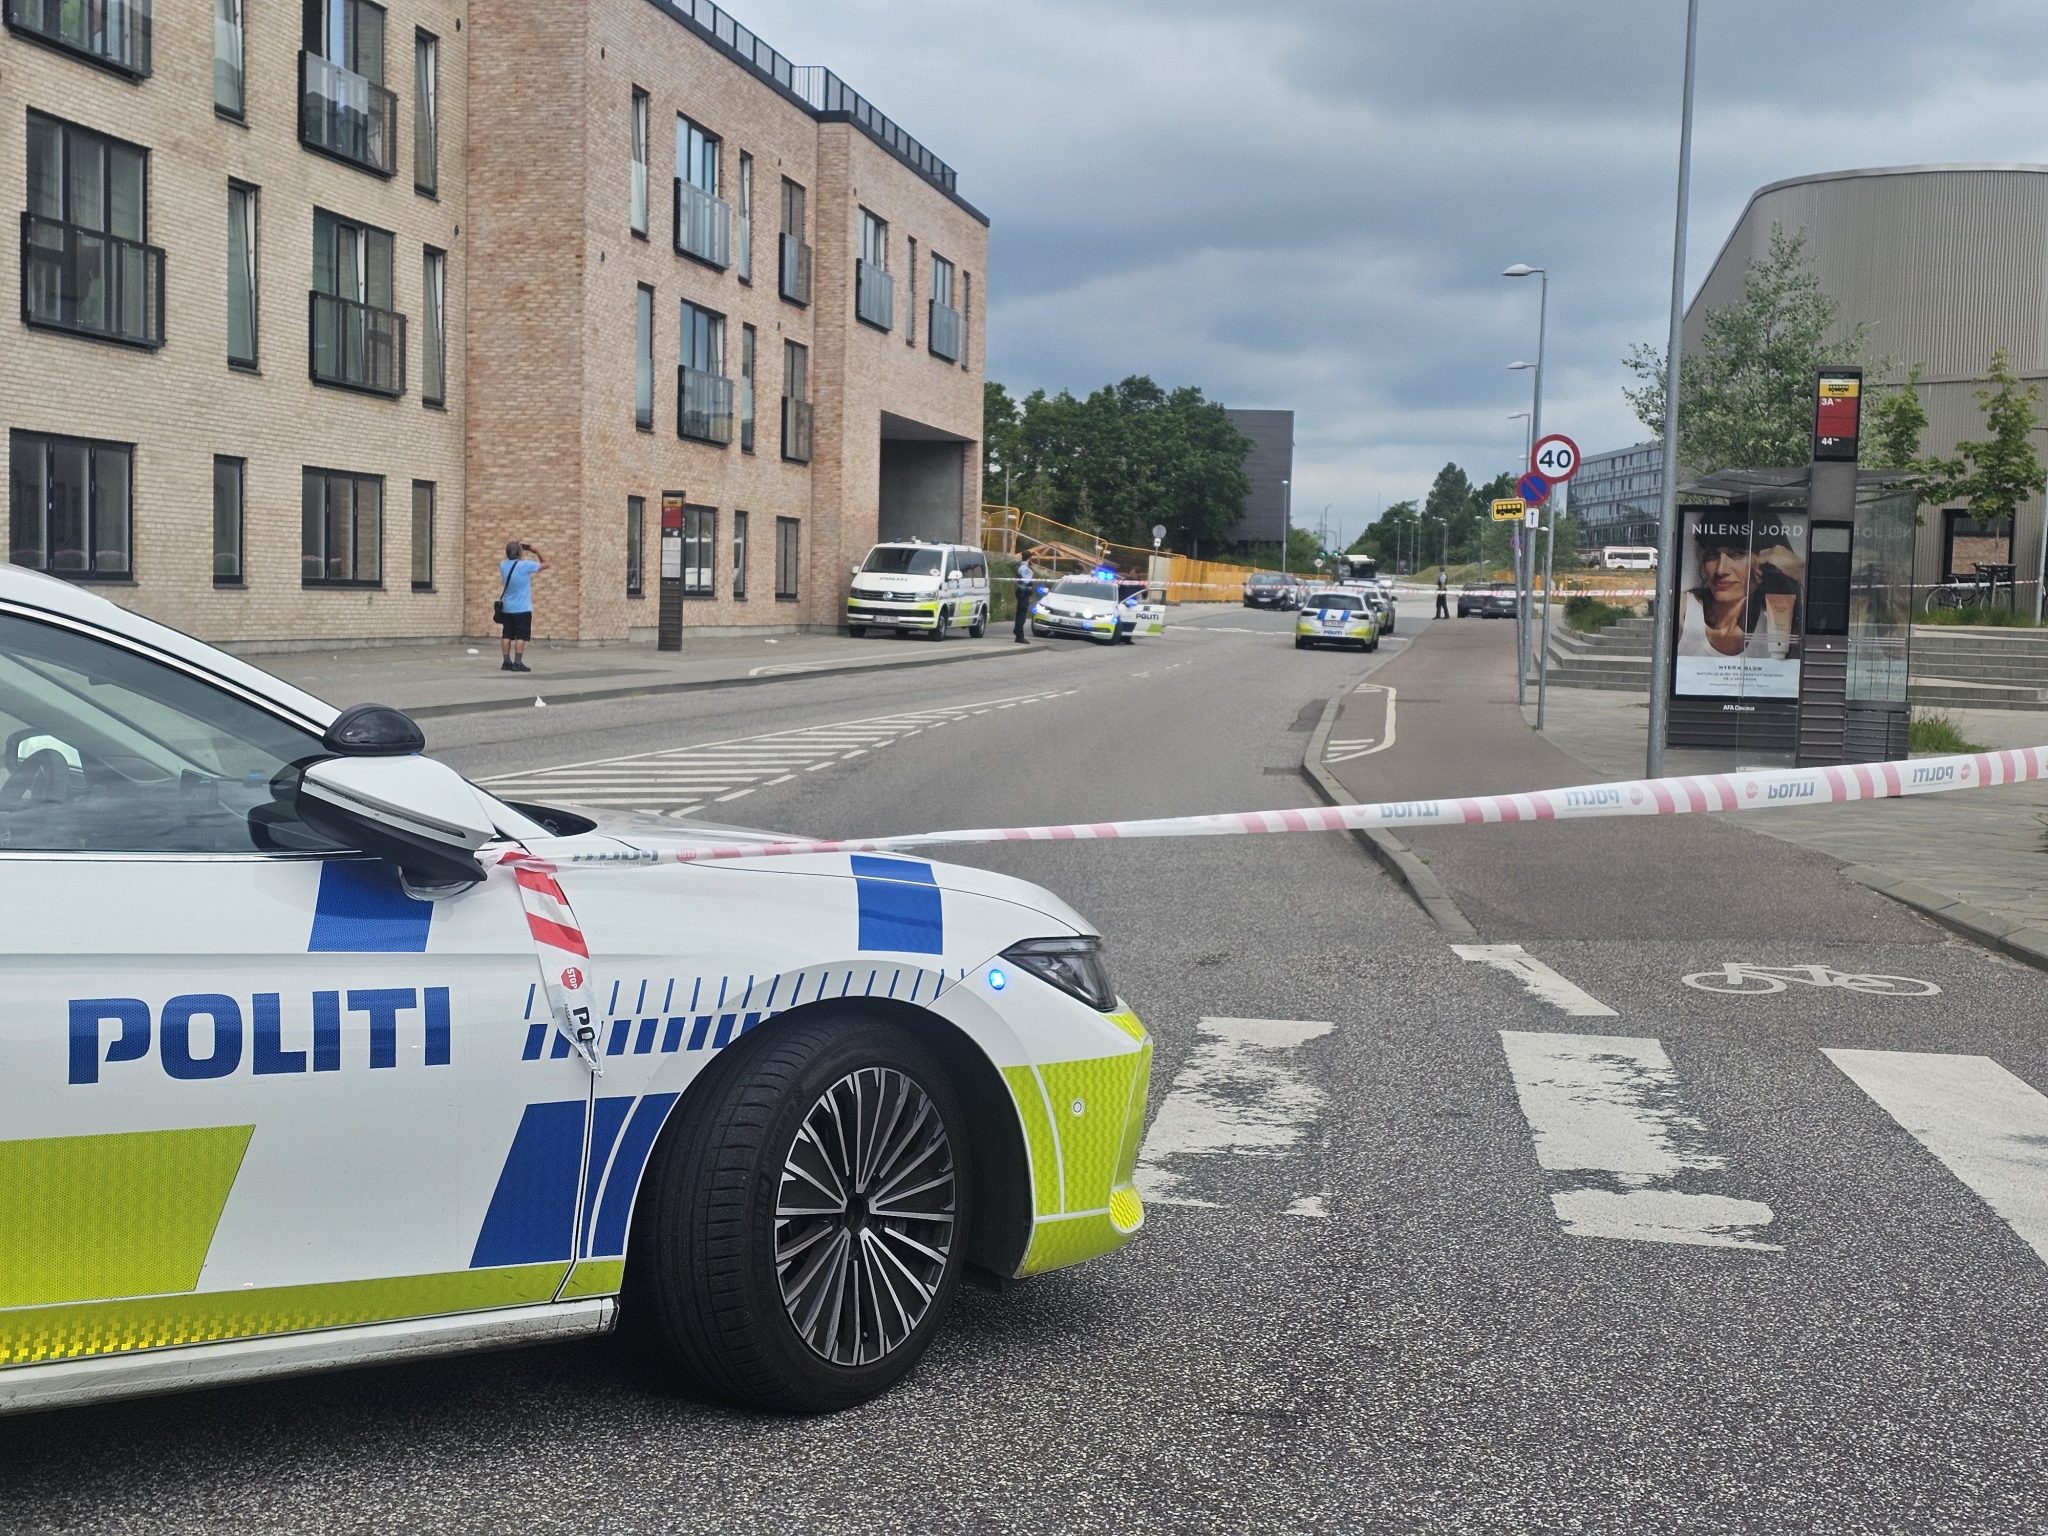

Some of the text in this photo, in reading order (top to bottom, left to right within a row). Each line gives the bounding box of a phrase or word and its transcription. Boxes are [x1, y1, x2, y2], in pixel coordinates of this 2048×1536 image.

[1821, 397, 1834, 406] 3A
[1821, 437, 1833, 445] 44
[1539, 450, 1572, 468] 40
[1692, 523, 1804, 537] NILENS JORD
[566, 968, 578, 989] STOP
[68, 986, 451, 1085] POLITI
